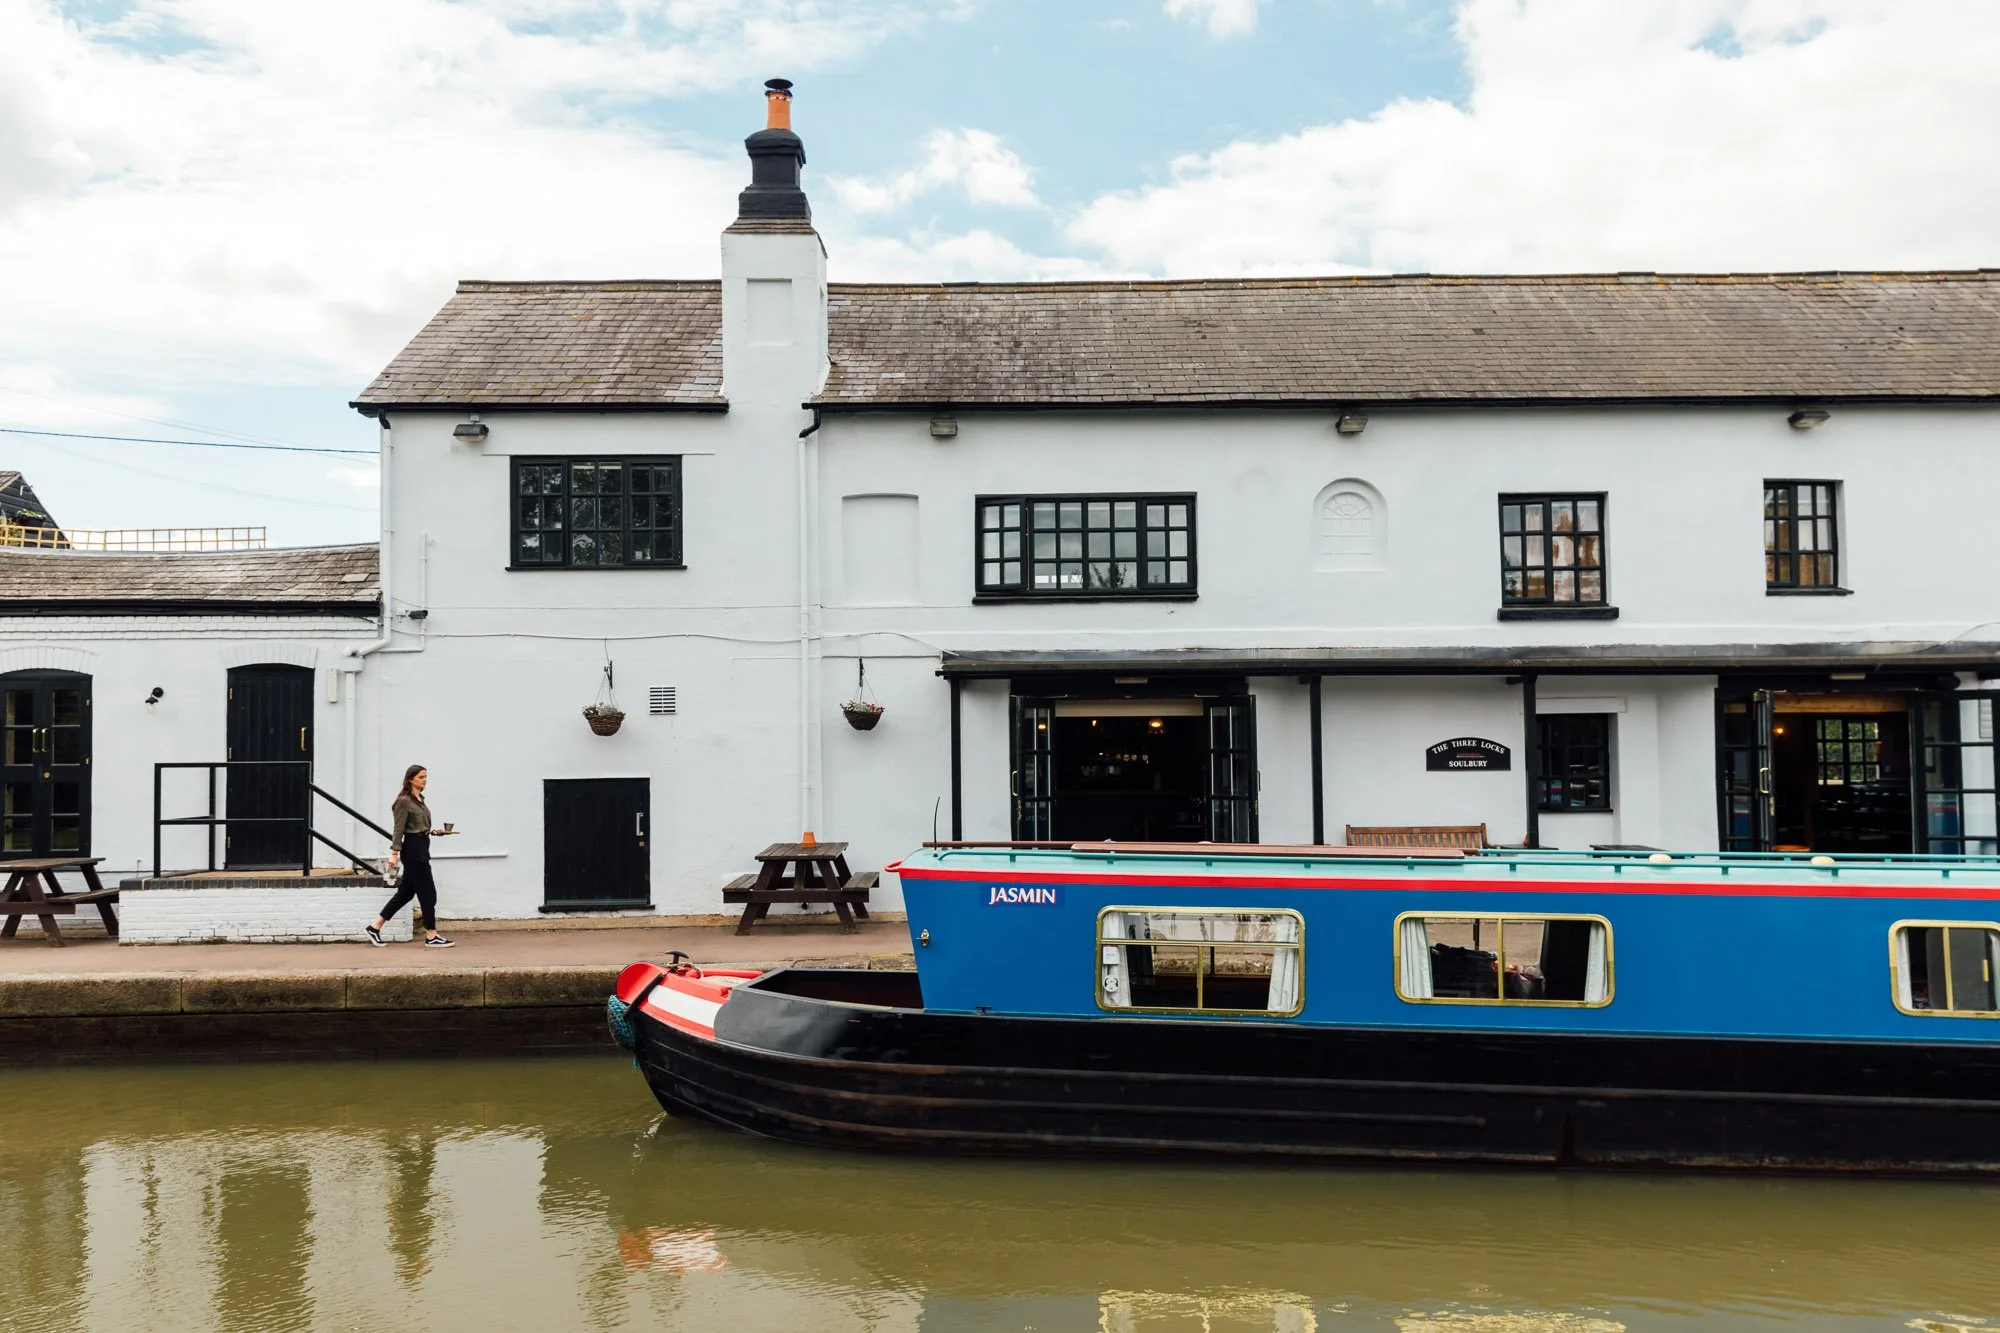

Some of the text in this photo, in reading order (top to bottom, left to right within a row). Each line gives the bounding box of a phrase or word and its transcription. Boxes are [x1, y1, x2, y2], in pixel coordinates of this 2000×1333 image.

[1432, 740, 1505, 754] THE THREE LOCKS
[988, 887, 1056, 905] JASMIN
